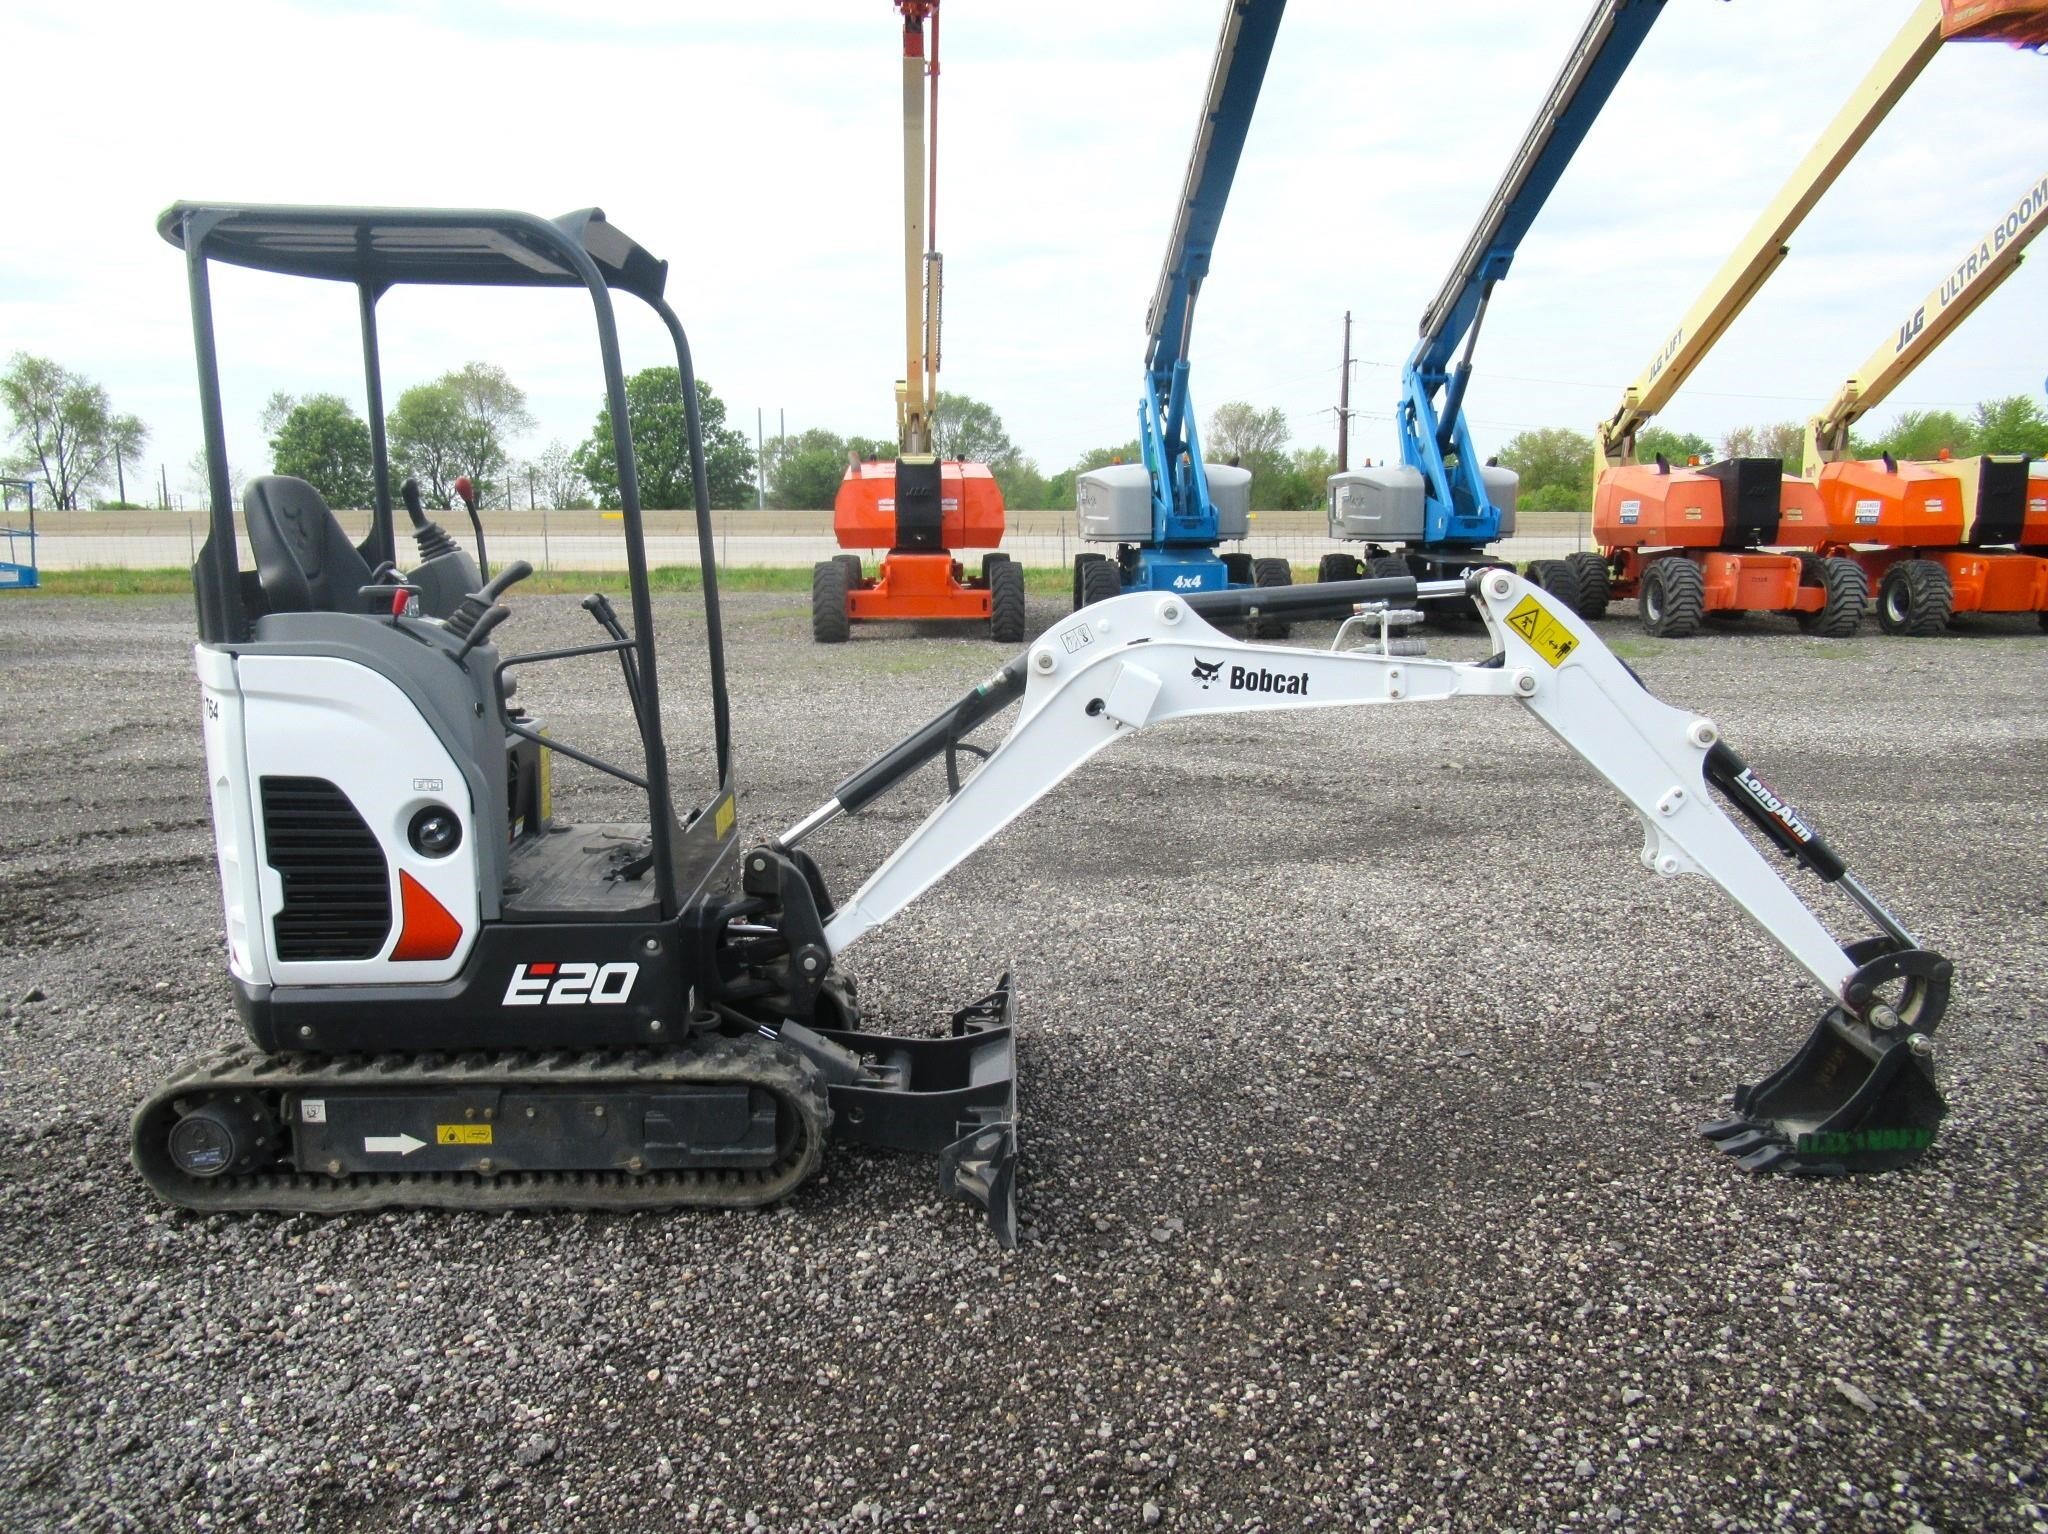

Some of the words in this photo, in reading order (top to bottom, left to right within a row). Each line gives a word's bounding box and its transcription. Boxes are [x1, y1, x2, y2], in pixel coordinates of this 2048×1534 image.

[1896, 306, 1925, 353] JLG
[1940, 242, 1990, 306] ULTRA
[1993, 177, 2048, 252] BOOM
[1649, 354, 1663, 383] JLG
[1665, 327, 1683, 361] LIFT
[1173, 575, 1202, 588] 4x4
[1229, 665, 1309, 695] Bobcat
[1733, 767, 1812, 842] LongArm
[502, 962, 640, 1005] E20
